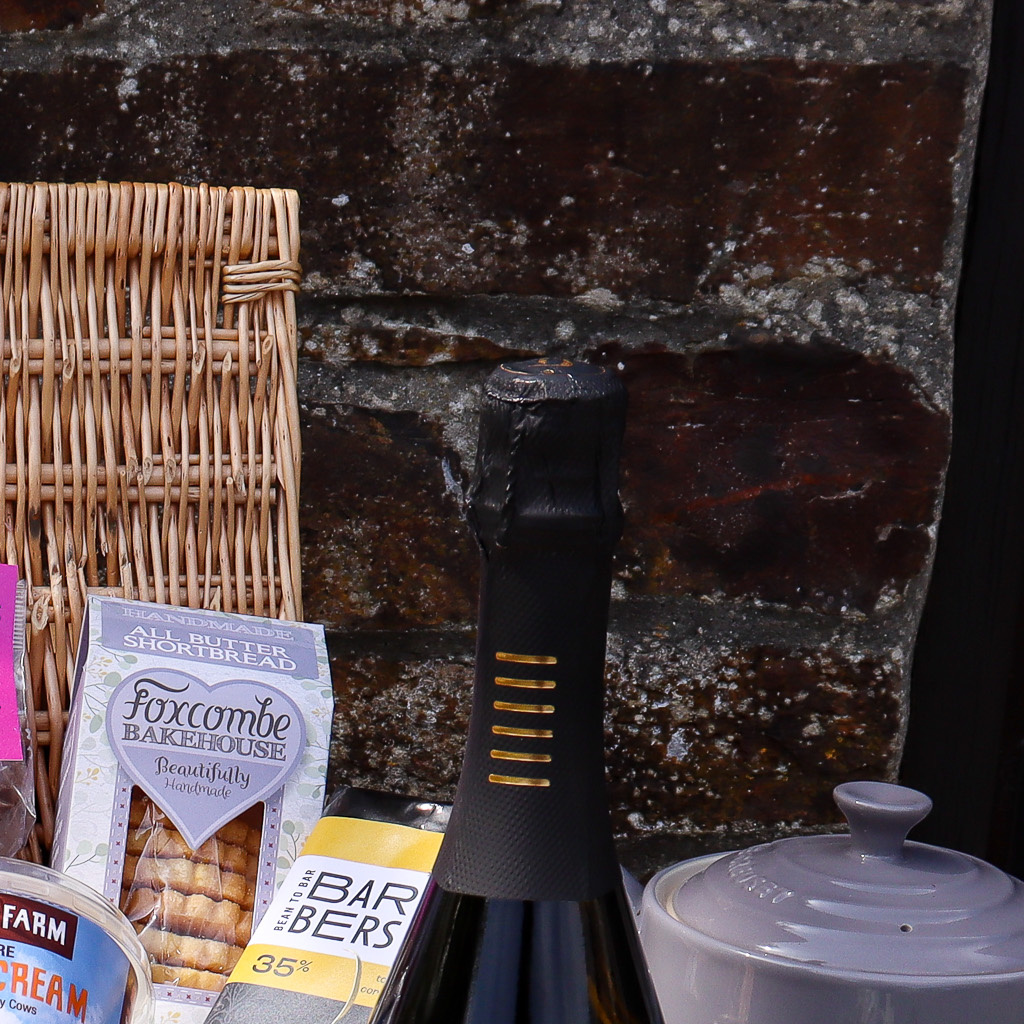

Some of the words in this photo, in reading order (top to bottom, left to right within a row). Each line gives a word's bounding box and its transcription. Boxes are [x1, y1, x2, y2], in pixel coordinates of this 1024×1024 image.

[122, 607, 295, 642] HANDMADE
[130, 625, 181, 642] ALL
[189, 632, 290, 658] BUTTER
[123, 635, 297, 671] SHORTBREAD
[121, 723, 288, 761] BAKEHOUSE
[154, 756, 251, 790] Beautifully
[164, 777, 233, 798] Handmade
[273, 907, 295, 932] BEAN
[289, 891, 303, 903] TO
[298, 869, 316, 888] BAR
[307, 870, 420, 916] BAR
[1, 904, 68, 946] FARM
[288, 904, 403, 949] BERS
[252, 954, 314, 978] 35%
[8, 998, 39, 1015] Cows
